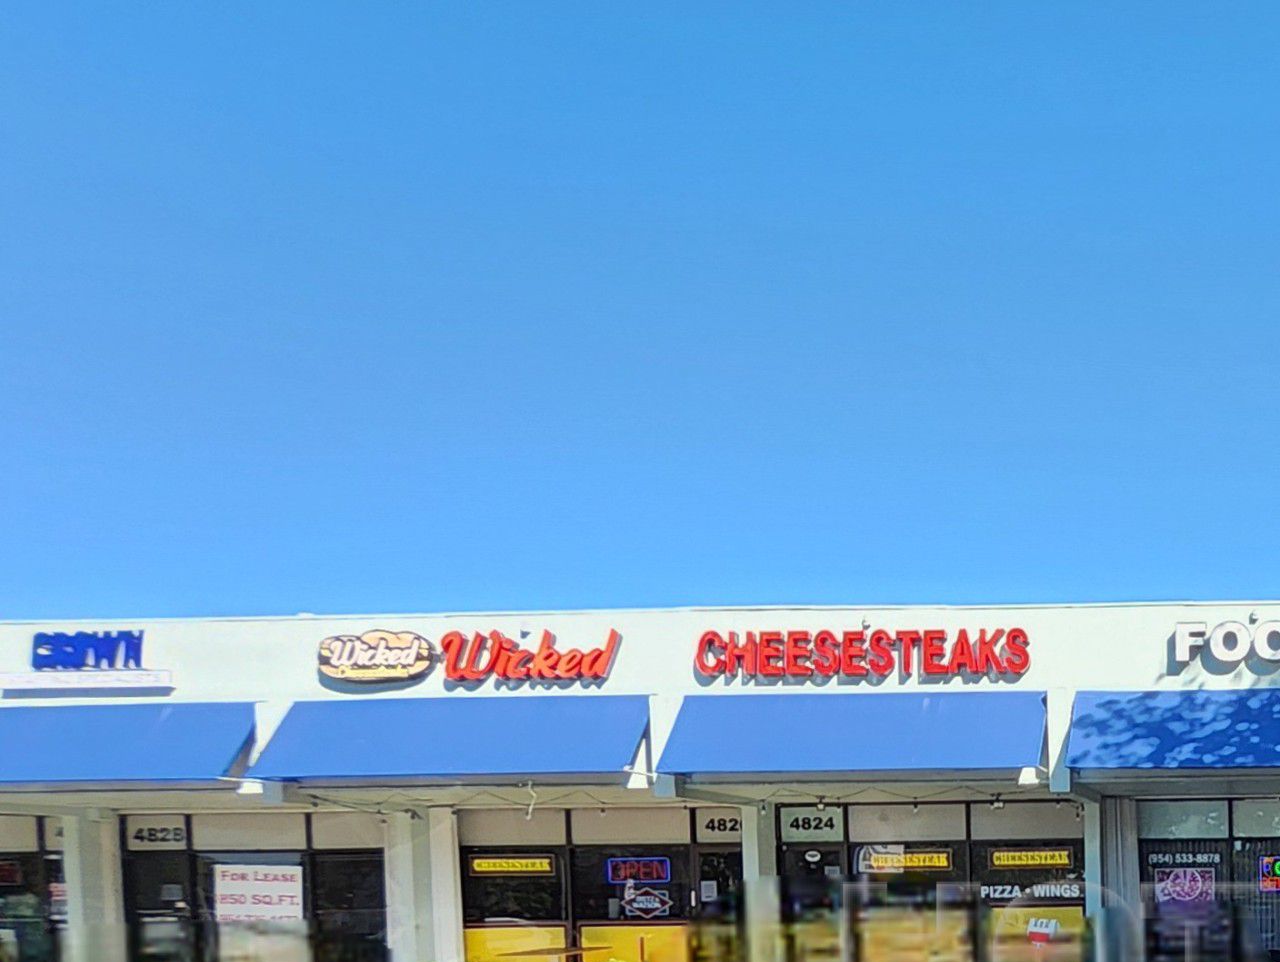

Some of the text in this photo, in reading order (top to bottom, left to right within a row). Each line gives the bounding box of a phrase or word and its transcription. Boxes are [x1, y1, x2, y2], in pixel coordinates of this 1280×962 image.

[328, 637, 420, 667] Wicked
[441, 628, 620, 681] Wicked
[694, 628, 1031, 676] CHEESESTEAKS
[705, 818, 743, 832] 482
[789, 816, 836, 831] 4824
[1148, 853, 1221, 865] (954) 533-8878
[611, 861, 667, 881] OPEN
[980, 884, 1080, 899] PIZZA WINGS
